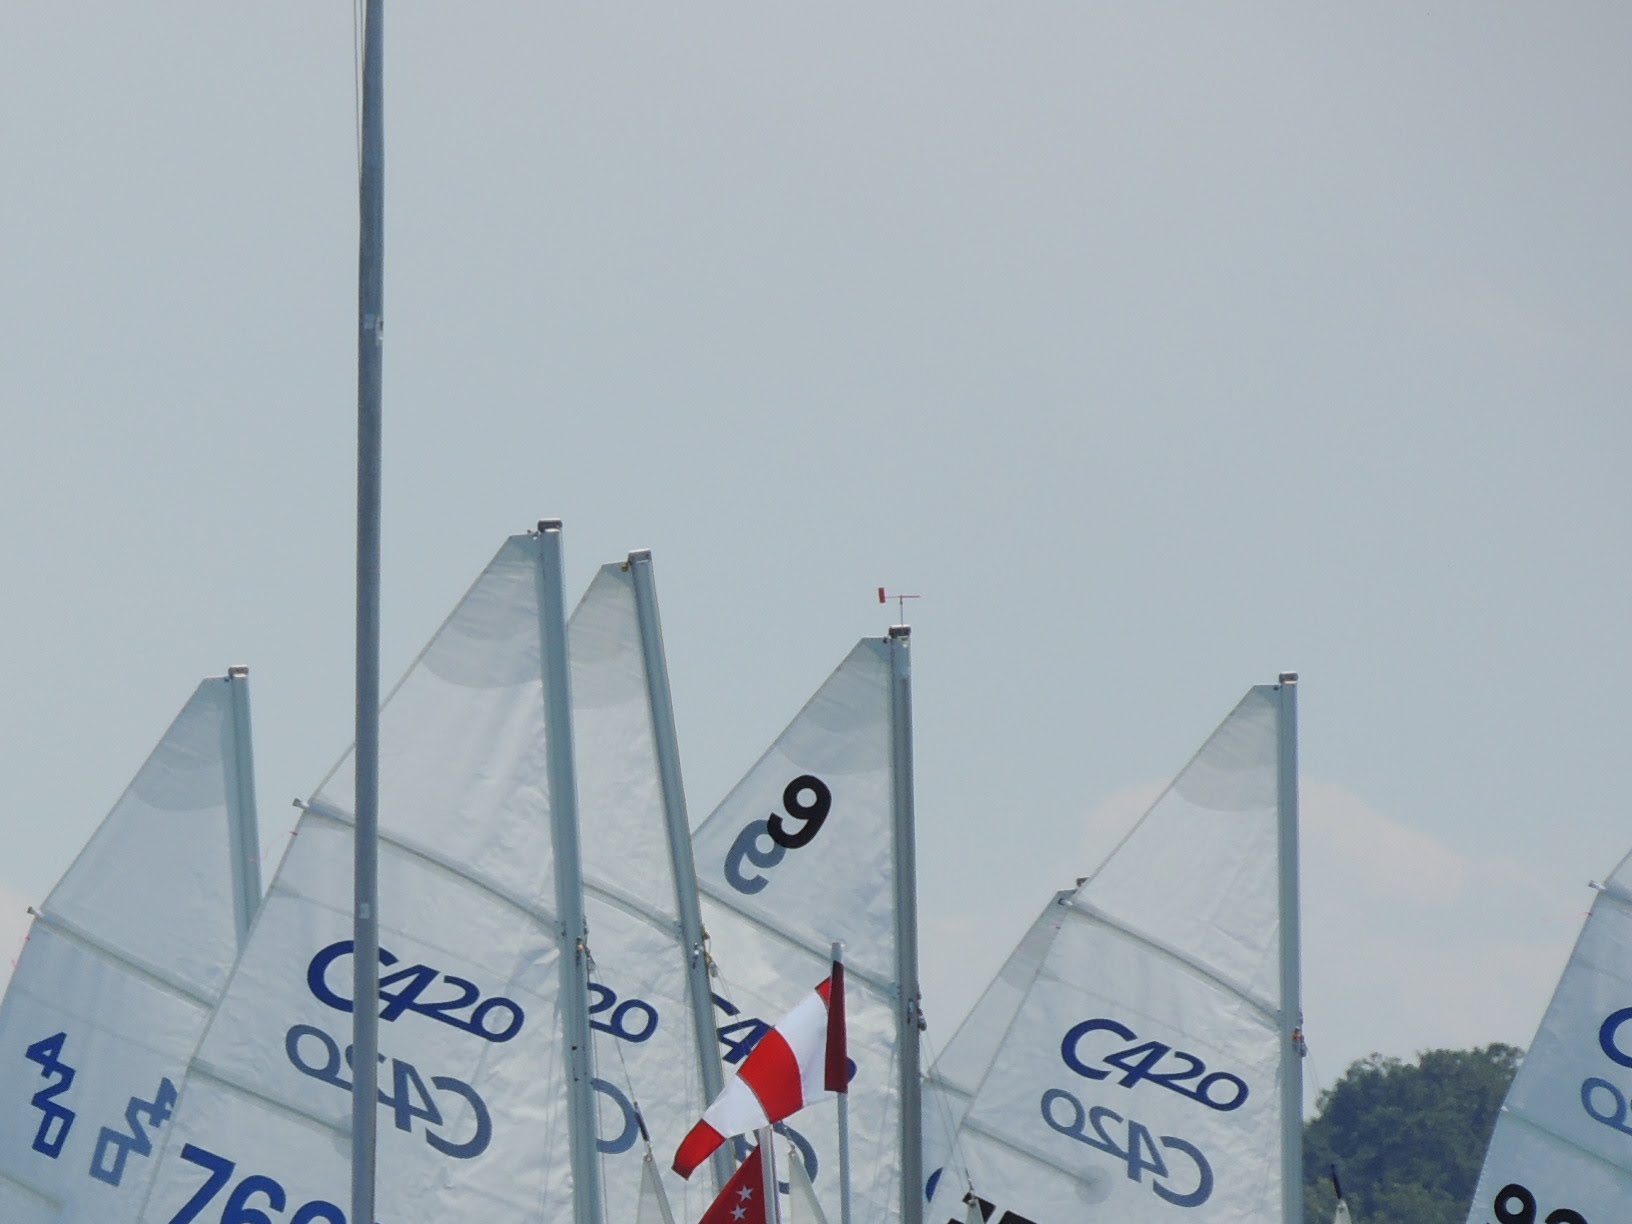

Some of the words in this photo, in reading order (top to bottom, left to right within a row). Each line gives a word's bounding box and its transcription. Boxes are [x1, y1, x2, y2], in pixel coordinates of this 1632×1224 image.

[767, 774, 832, 849] 9
[307, 940, 524, 1043] C420
[26, 1032, 76, 1159] 420
[1061, 1018, 1249, 1111] C420
